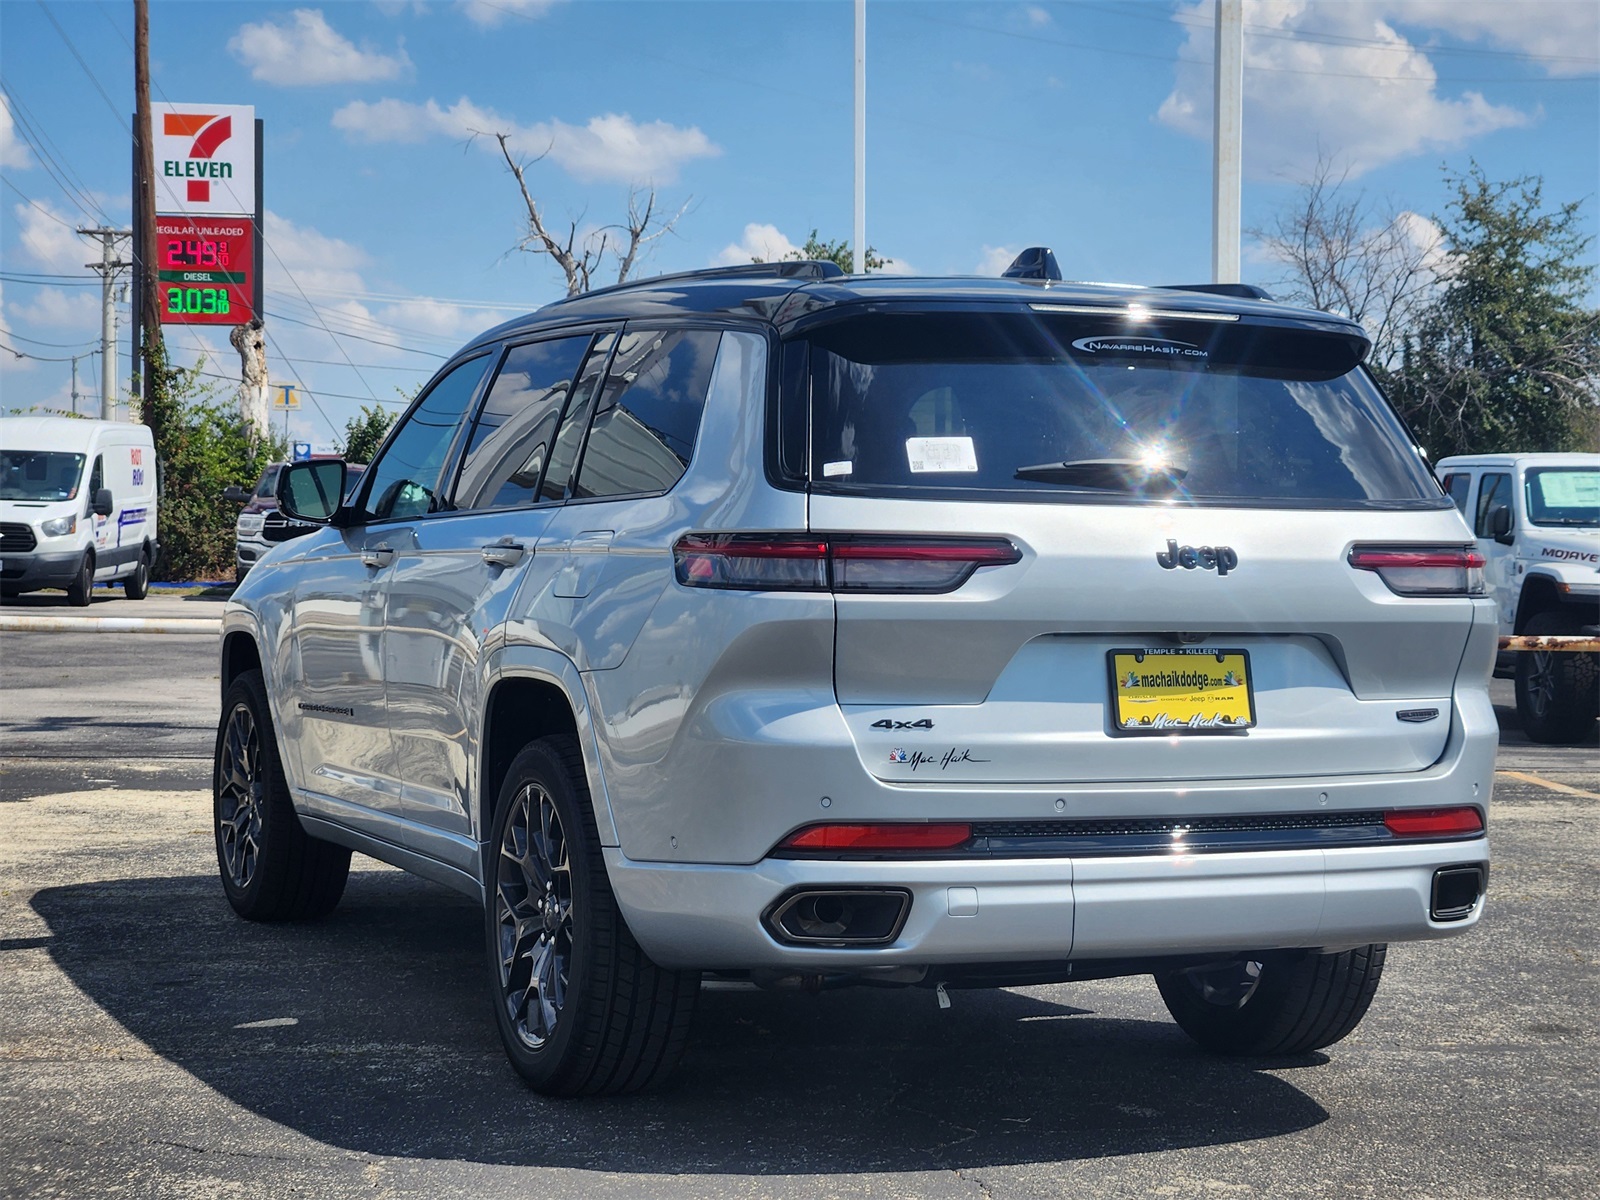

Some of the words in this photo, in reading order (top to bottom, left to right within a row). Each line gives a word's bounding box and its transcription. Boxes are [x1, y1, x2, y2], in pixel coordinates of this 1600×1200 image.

[164, 113, 231, 202] 7
[198, 227, 244, 236] UNLEADED
[167, 240, 217, 266] 2.49
[183, 273, 213, 281] DIESEL
[167, 287, 217, 313] 3.03
[1156, 538, 1238, 576] Jeep
[1541, 547, 1600, 563] MOJAVE
[1141, 670, 1223, 690] machaikdodge.com
[1189, 695, 1206, 703] Jeep
[870, 718, 936, 730] 4x4
[1149, 712, 1187, 729] Mac
[1187, 712, 1226, 729] Haik
[909, 751, 937, 772] Mac
[939, 747, 991, 771] Haik
